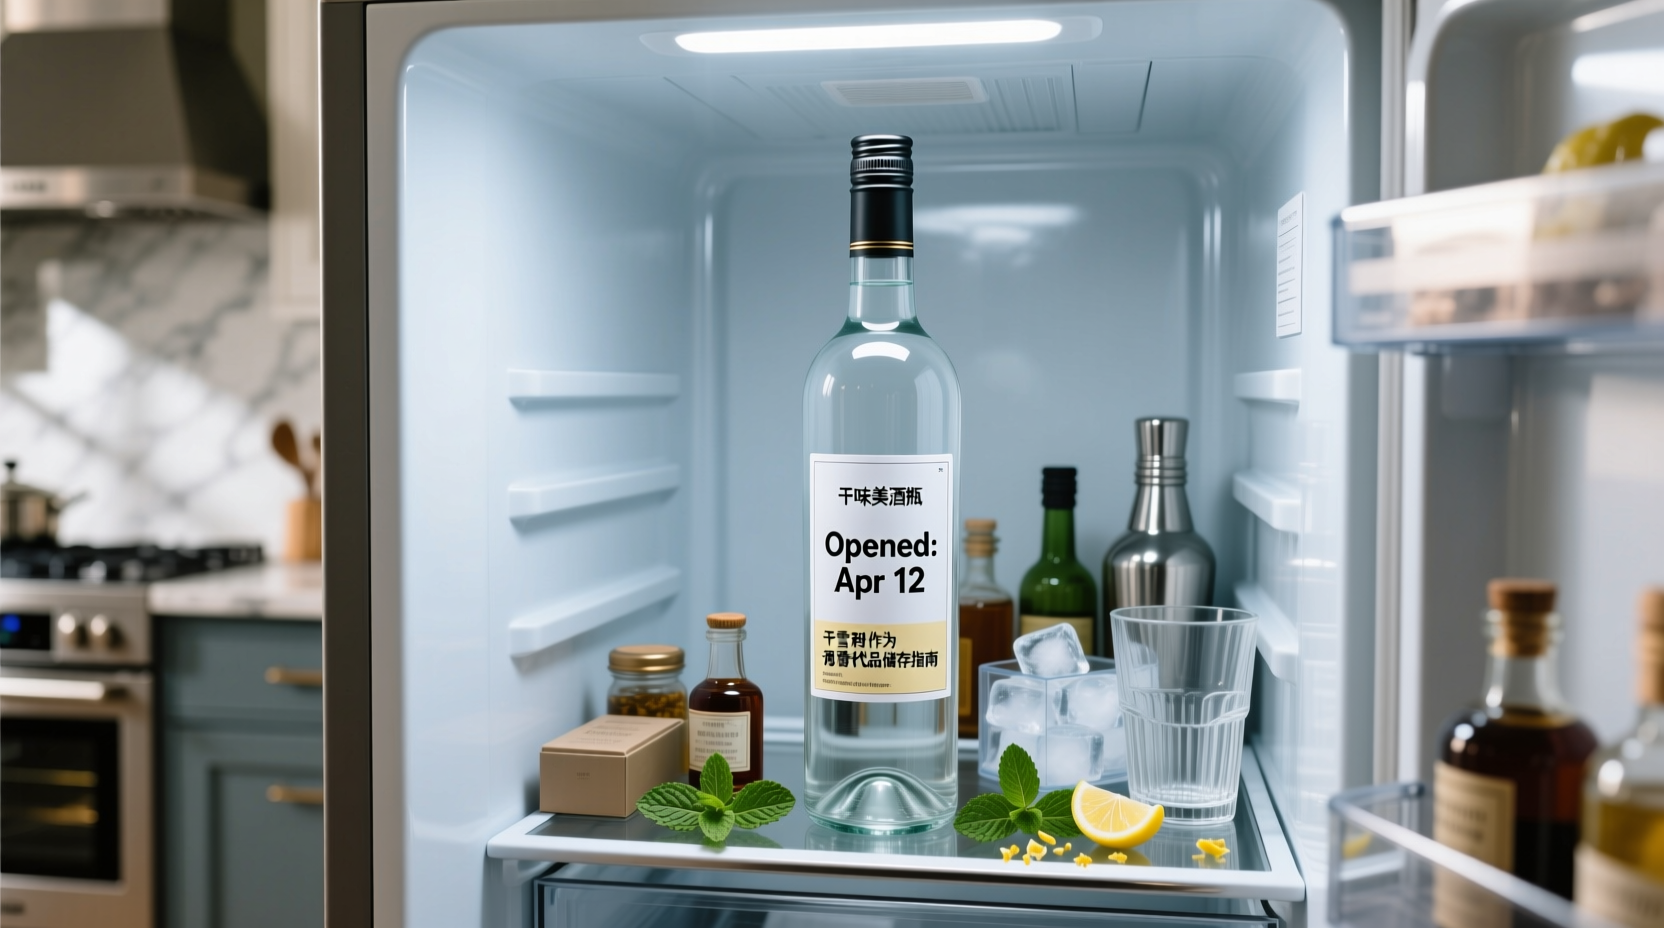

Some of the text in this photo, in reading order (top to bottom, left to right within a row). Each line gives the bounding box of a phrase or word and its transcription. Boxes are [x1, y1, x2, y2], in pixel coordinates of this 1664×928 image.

[825, 531, 937, 563] Opened:
[834, 566, 925, 600] Apr 12
